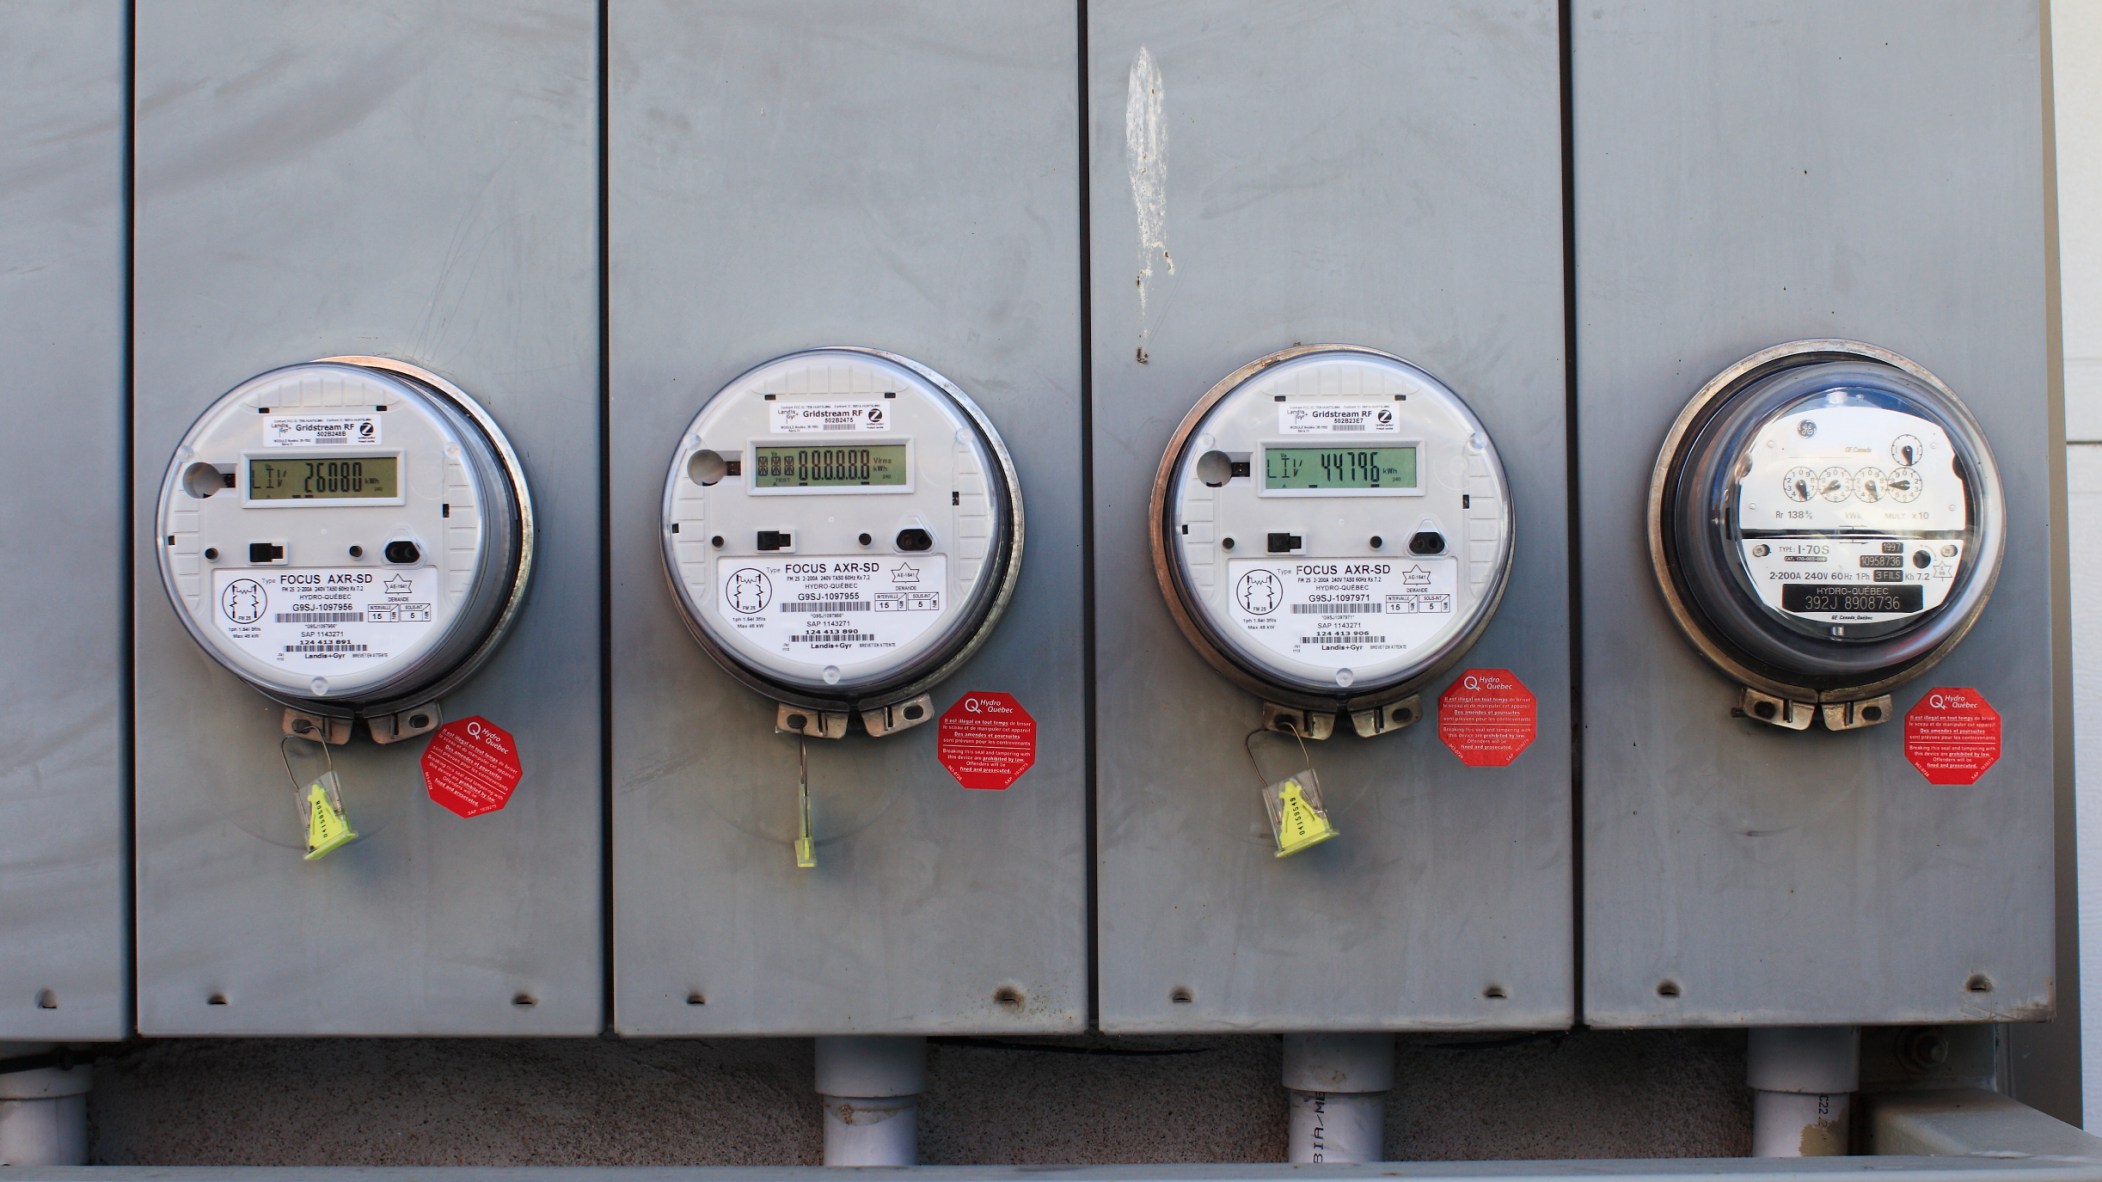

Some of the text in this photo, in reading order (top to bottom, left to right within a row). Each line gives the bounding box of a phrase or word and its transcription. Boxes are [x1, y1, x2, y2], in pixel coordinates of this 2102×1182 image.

[1267, 457, 1302, 478] LIV
[1321, 452, 1379, 482] 44796
[252, 468, 286, 488] LIV
[305, 462, 362, 492] 26080
[1798, 545, 1829, 554] I-70S
[1861, 557, 1901, 566] 10958736
[786, 564, 826, 573] FOCUS
[834, 563, 879, 572] AXR-SD
[1296, 565, 1337, 575] FOCUS
[1345, 565, 1391, 574] AXR-SD
[280, 575, 320, 584] FOCUS
[328, 574, 372, 583] AXR-SD
[1770, 572, 1801, 580] 2-200A
[1805, 572, 1828, 580] 240V
[1816, 586, 1889, 595] HYDRO-QUÉBEC
[798, 592, 859, 600] G9SJ-1097955
[1805, 596, 1900, 610] 392J 8908736
[482, 728, 501, 742] Hydro
